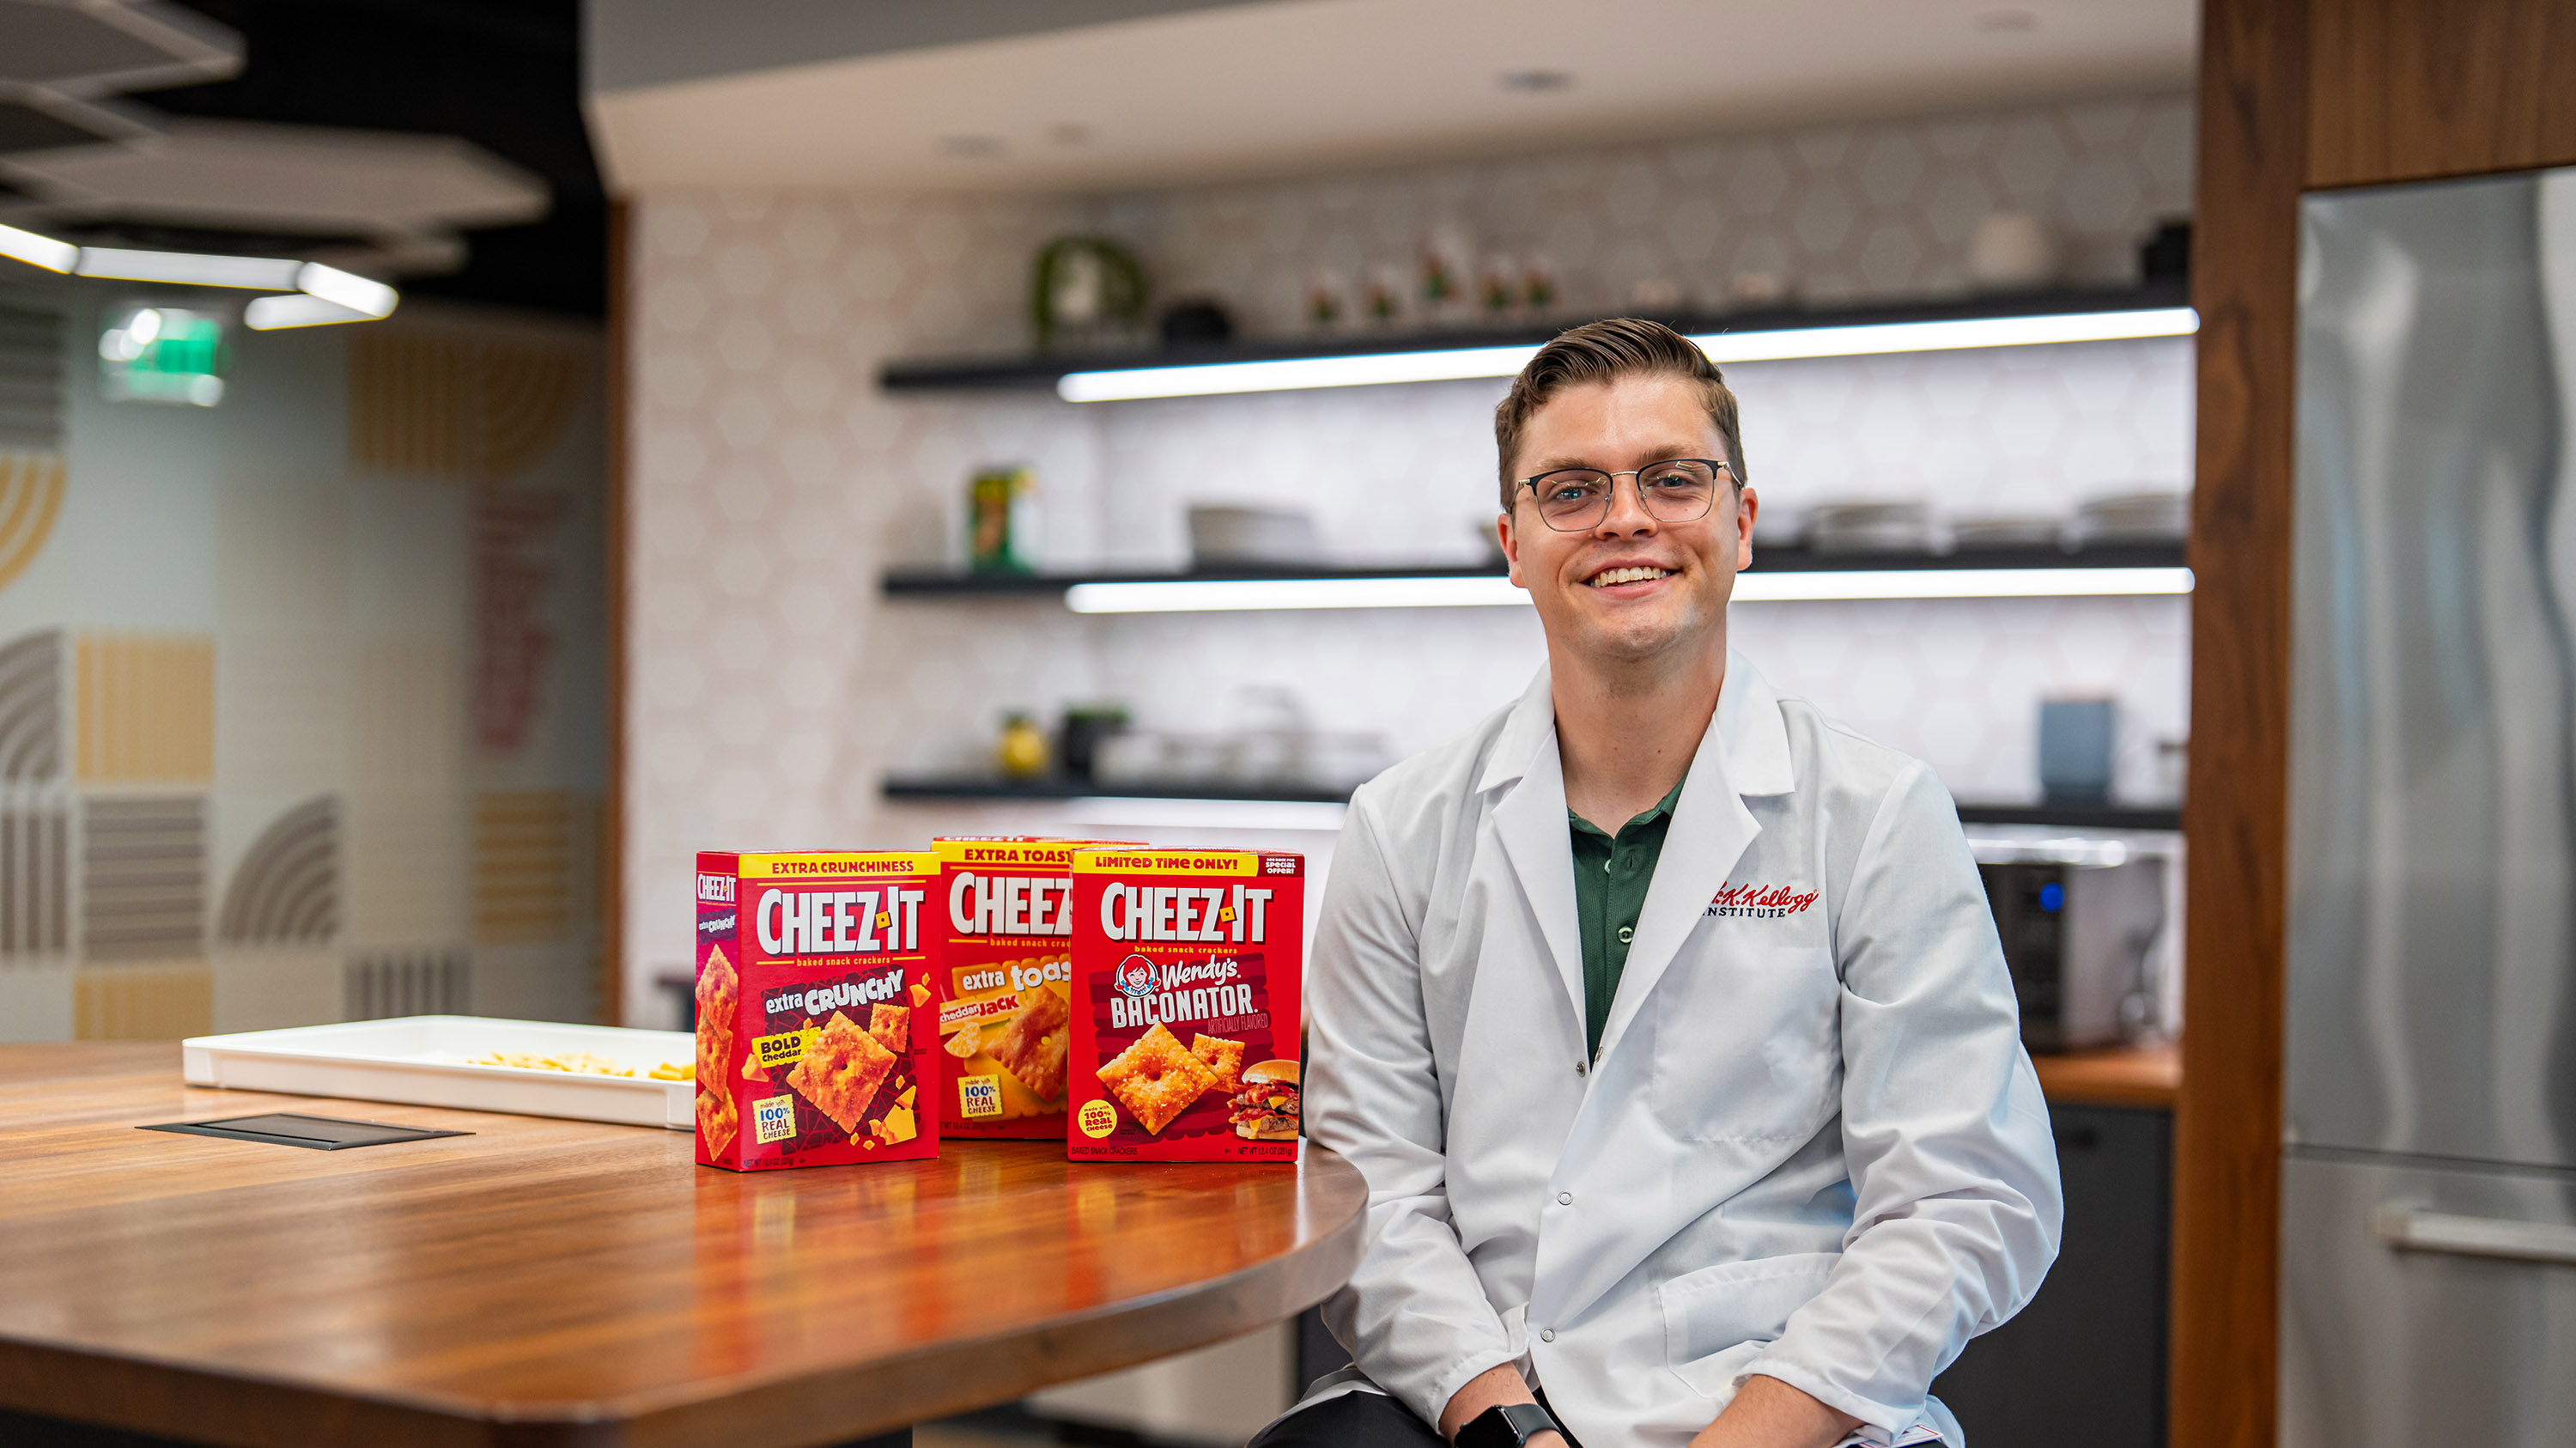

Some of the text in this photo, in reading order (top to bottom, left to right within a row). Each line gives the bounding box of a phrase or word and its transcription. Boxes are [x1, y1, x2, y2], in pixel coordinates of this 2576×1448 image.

[964, 849, 1019, 861] EXTRA
[772, 861, 914, 874] EXTRA CRUNCHINESS
[1193, 858, 1238, 870] ONLY!
[1703, 907, 1786, 918] NSTITUTE
[990, 938, 1018, 946] baked
[1021, 939, 1048, 947] snack
[797, 956, 890, 967] baked snack crackers
[1161, 954, 1238, 990] Wendy's
[963, 970, 1005, 991] extra
[766, 969, 904, 1016] extra CRUNCHY
[1110, 983, 1254, 1029] BACONATOR
[939, 1003, 978, 1023] cheddar
[1207, 1013, 1269, 1035] ARTIFICIALLY FLAVORED
[760, 1036, 801, 1055] BOLD
[964, 1086, 996, 1098] 100%
[966, 1096, 995, 1108] REAL
[760, 1107, 791, 1122] 100%
[968, 1105, 996, 1115] CHEESE
[1084, 1110, 1111, 1120] 100%
[762, 1118, 791, 1133] REAL
[763, 1129, 791, 1140] CHEESE
[1071, 1146, 1138, 1155] BAKED SNACK CRACKERS
[1237, 1147, 1249, 1155] NET
[1249, 1147, 1257, 1155] WT
[1269, 1147, 1277, 1155] OZ
